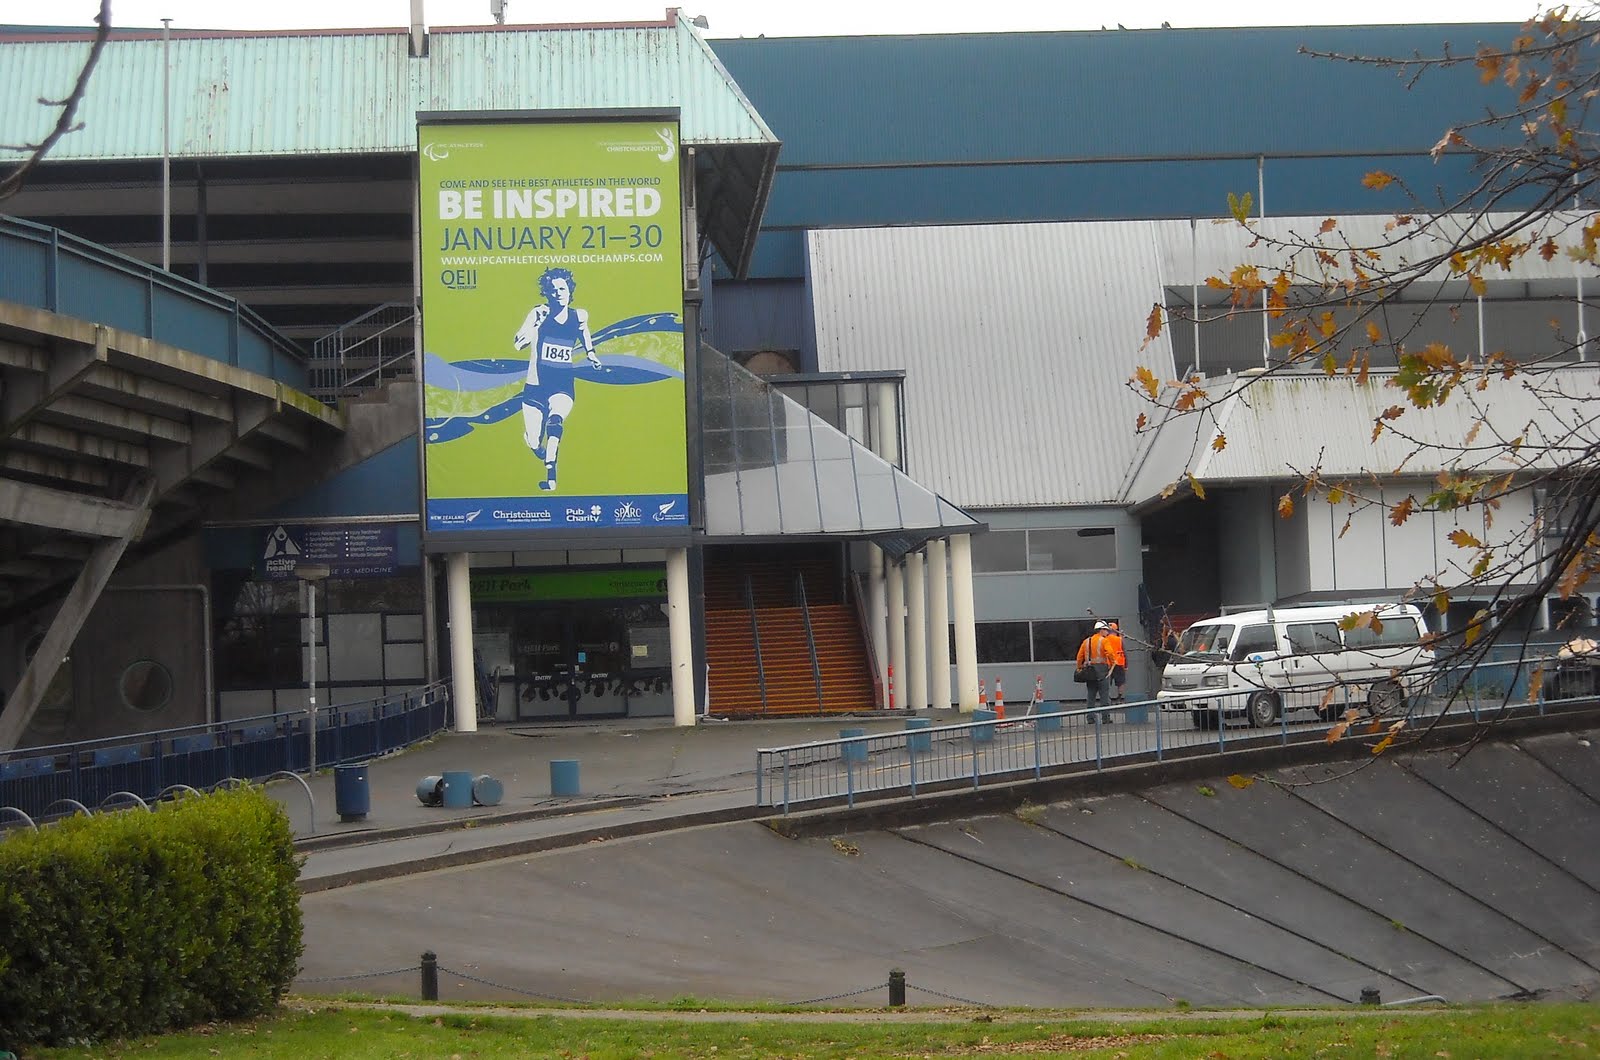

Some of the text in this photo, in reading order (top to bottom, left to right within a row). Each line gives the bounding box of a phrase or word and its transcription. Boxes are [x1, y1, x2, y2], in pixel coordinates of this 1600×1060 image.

[440, 180, 466, 188] COME
[469, 180, 489, 188] AND
[491, 180, 507, 188] SEE
[509, 179, 526, 187] THE
[529, 179, 549, 187] BEST
[552, 178, 594, 187] ATHLETES
[608, 178, 625, 186] THE
[627, 178, 660, 186] WORLD
[439, 188, 661, 220] BE INSPIRED
[440, 226, 572, 251] JANUARY
[441, 254, 663, 266] WWW.IPCATHLETICSWORLDCHAMPS.COM
[441, 270, 477, 289] QEII
[546, 346, 570, 361] 1845
[493, 510, 551, 519] Christchurch
[566, 514, 600, 523] Charity
[614, 506, 642, 519] SPARC
